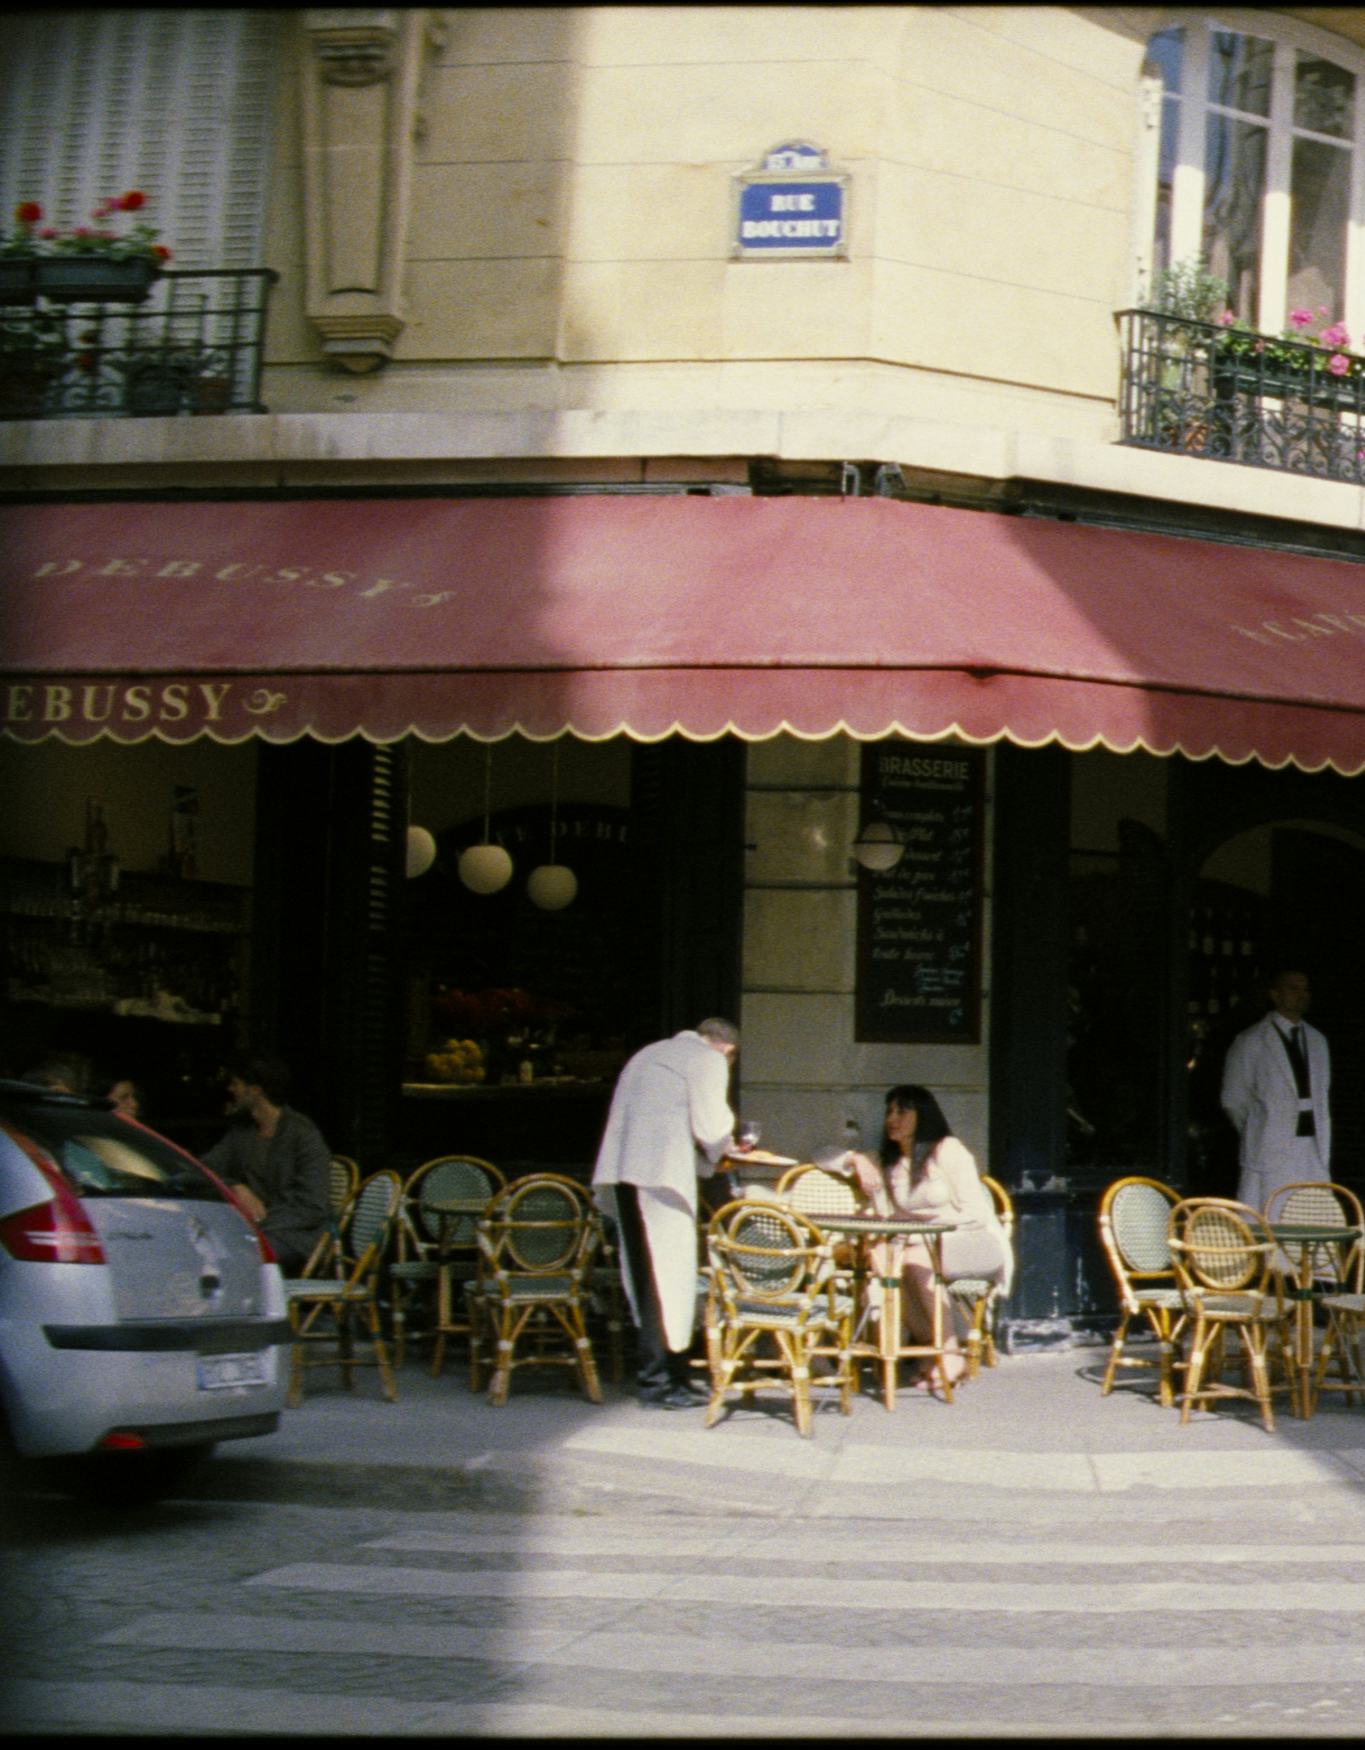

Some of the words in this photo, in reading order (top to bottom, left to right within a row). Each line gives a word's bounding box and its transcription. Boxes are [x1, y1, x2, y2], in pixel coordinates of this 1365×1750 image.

[770, 194, 815, 212] RUE
[742, 220, 840, 238] BOUCHUT
[33, 559, 413, 599] DEBUSSY
[879, 756, 970, 780] BRASSERIE
